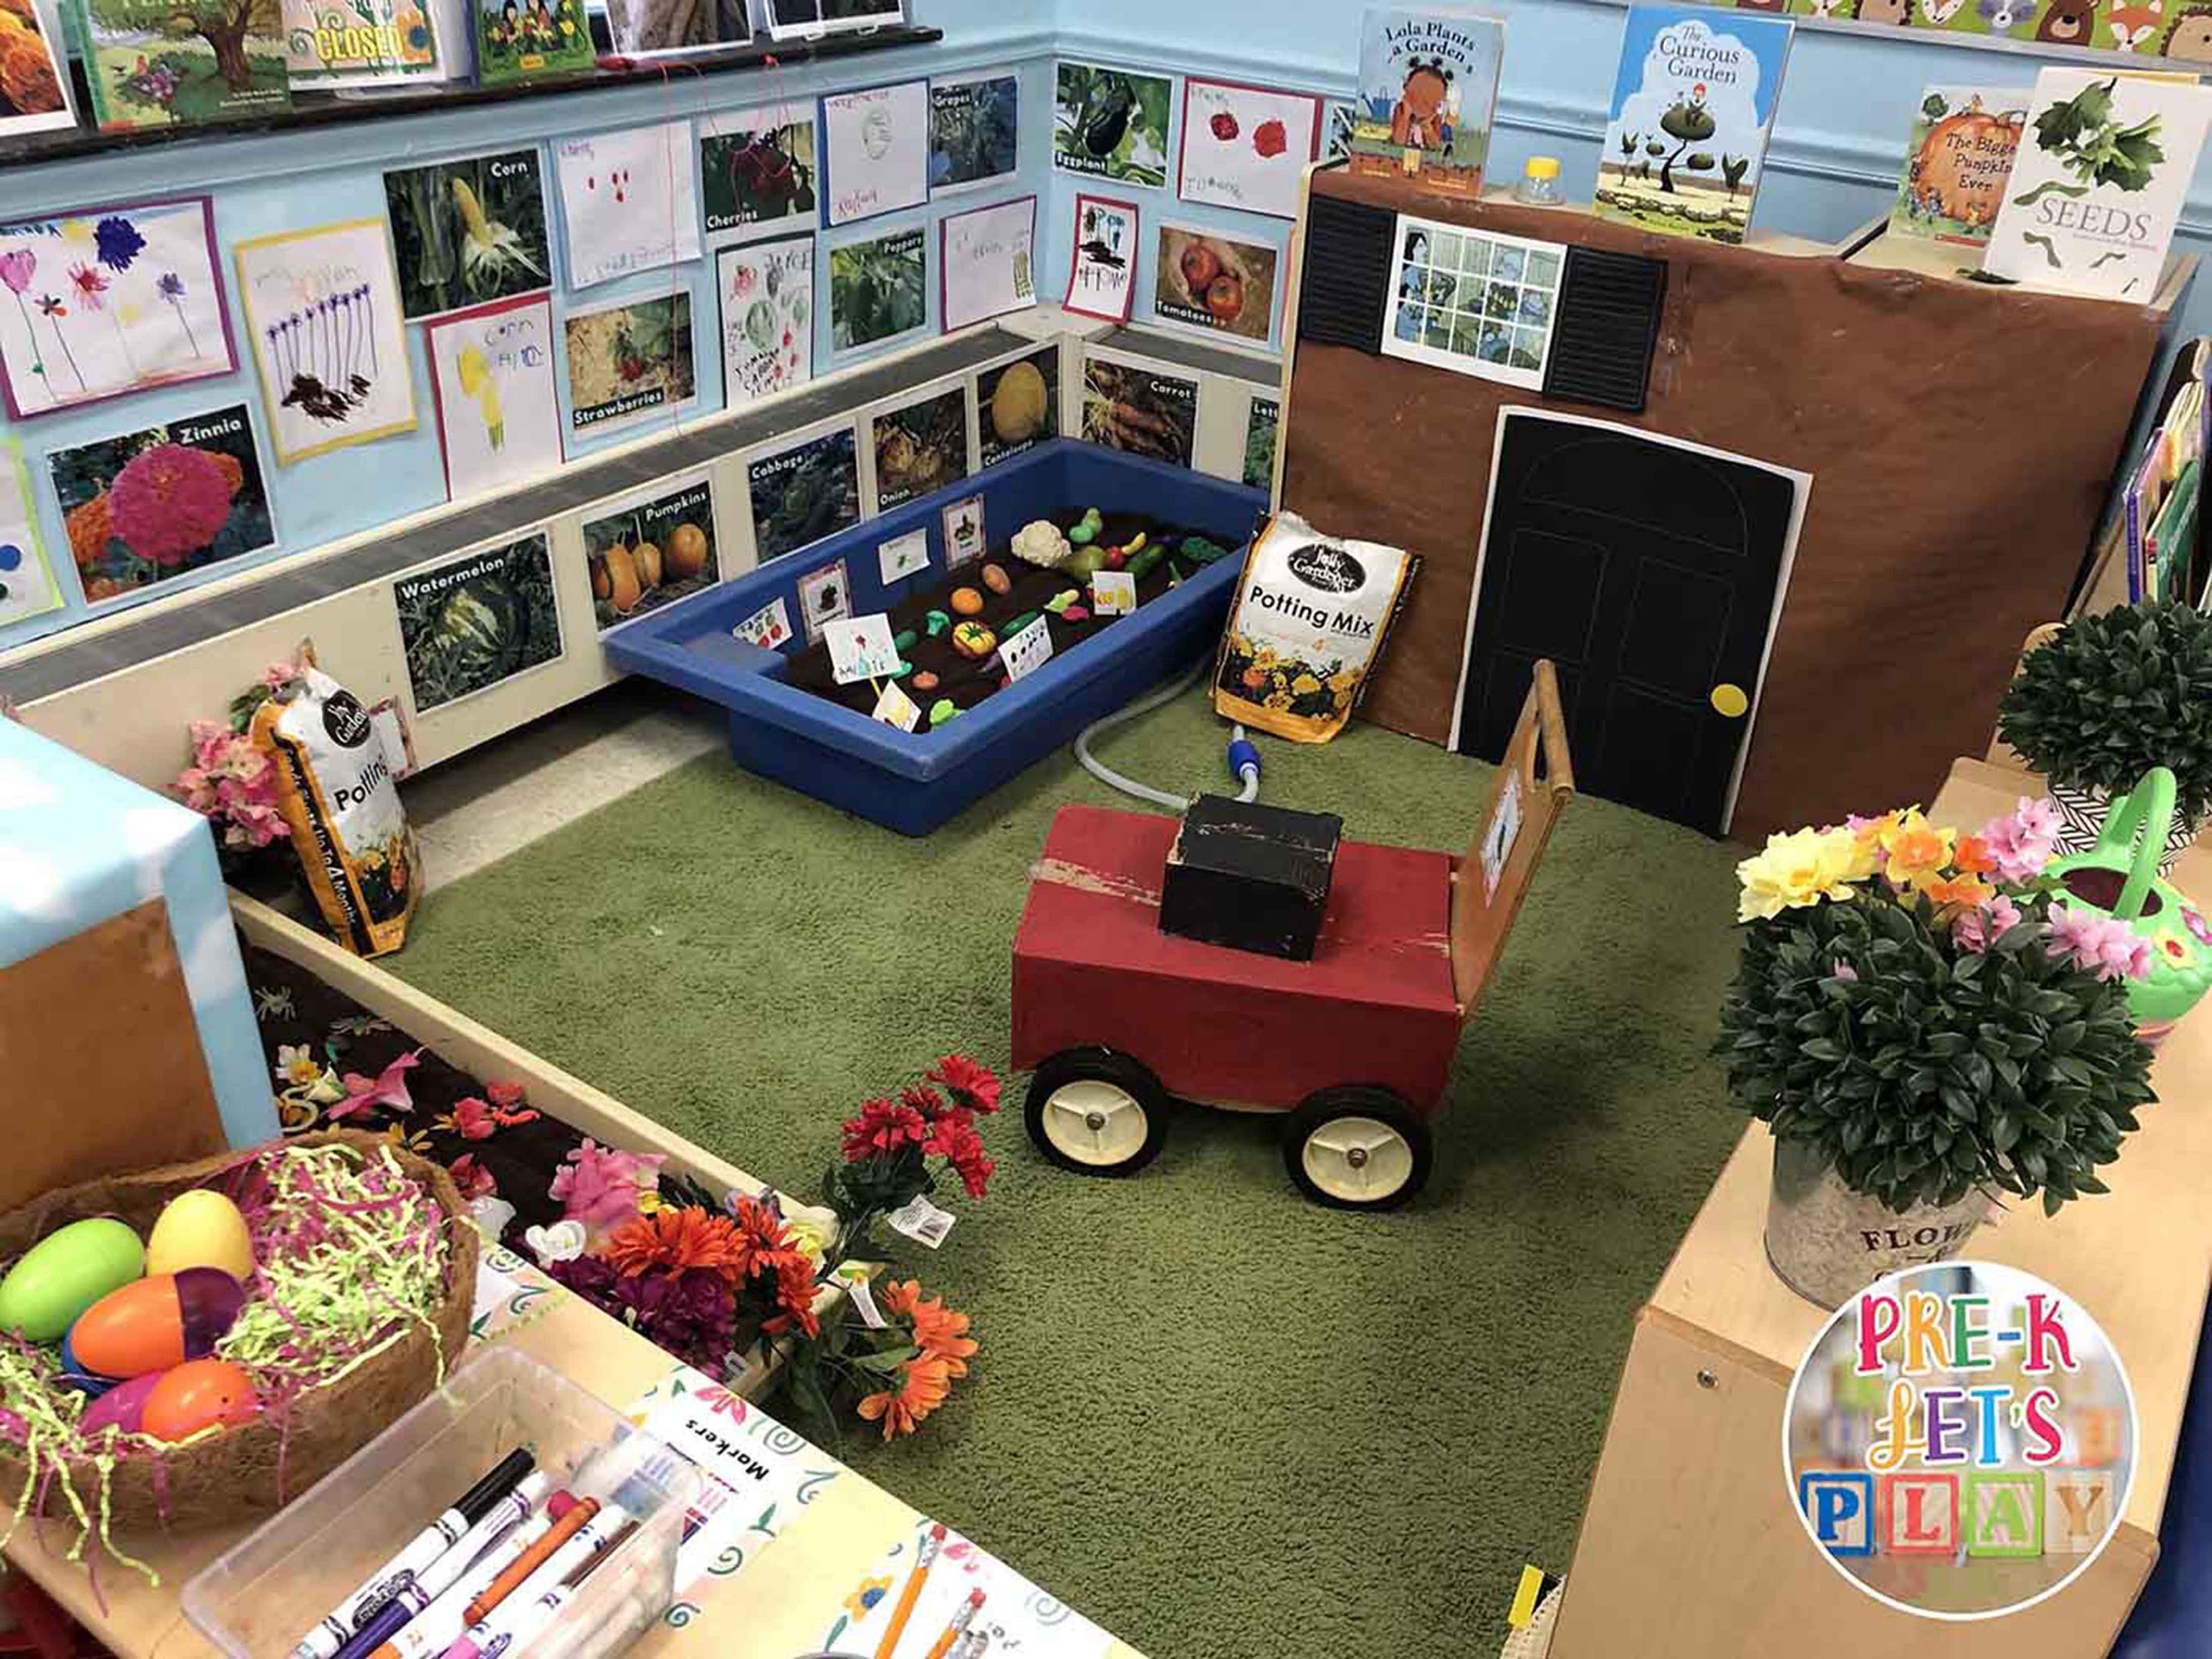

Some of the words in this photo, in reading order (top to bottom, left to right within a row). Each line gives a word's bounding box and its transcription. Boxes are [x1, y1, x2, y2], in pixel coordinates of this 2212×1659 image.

[315, 25, 403, 60] CLOSED
[1385, 21, 1421, 42] Lola
[1426, 22, 1476, 51] Plants
[1660, 35, 1740, 63] Curious
[1406, 37, 1465, 63] Garden
[1668, 58, 1737, 84] Garden
[1946, 132, 1972, 149] The
[490, 161, 529, 178] Corn
[1959, 174, 1993, 191] Ever
[707, 210, 757, 228] Cherries
[2036, 197, 2152, 240] SEEDS
[1157, 300, 1212, 323] Tomatoes
[1150, 380, 1191, 398] Carrot
[575, 392, 662, 424] Strawberries
[179, 418, 243, 445] Zinnia
[752, 454, 803, 479] Cabbage
[645, 492, 707, 521] Pumpkins
[880, 489, 911, 505] Onion
[402, 558, 505, 599] Watermelon
[1250, 585, 1328, 629] Potting
[1331, 612, 1374, 634] Mix
[685, 1419, 769, 1480] Markers
